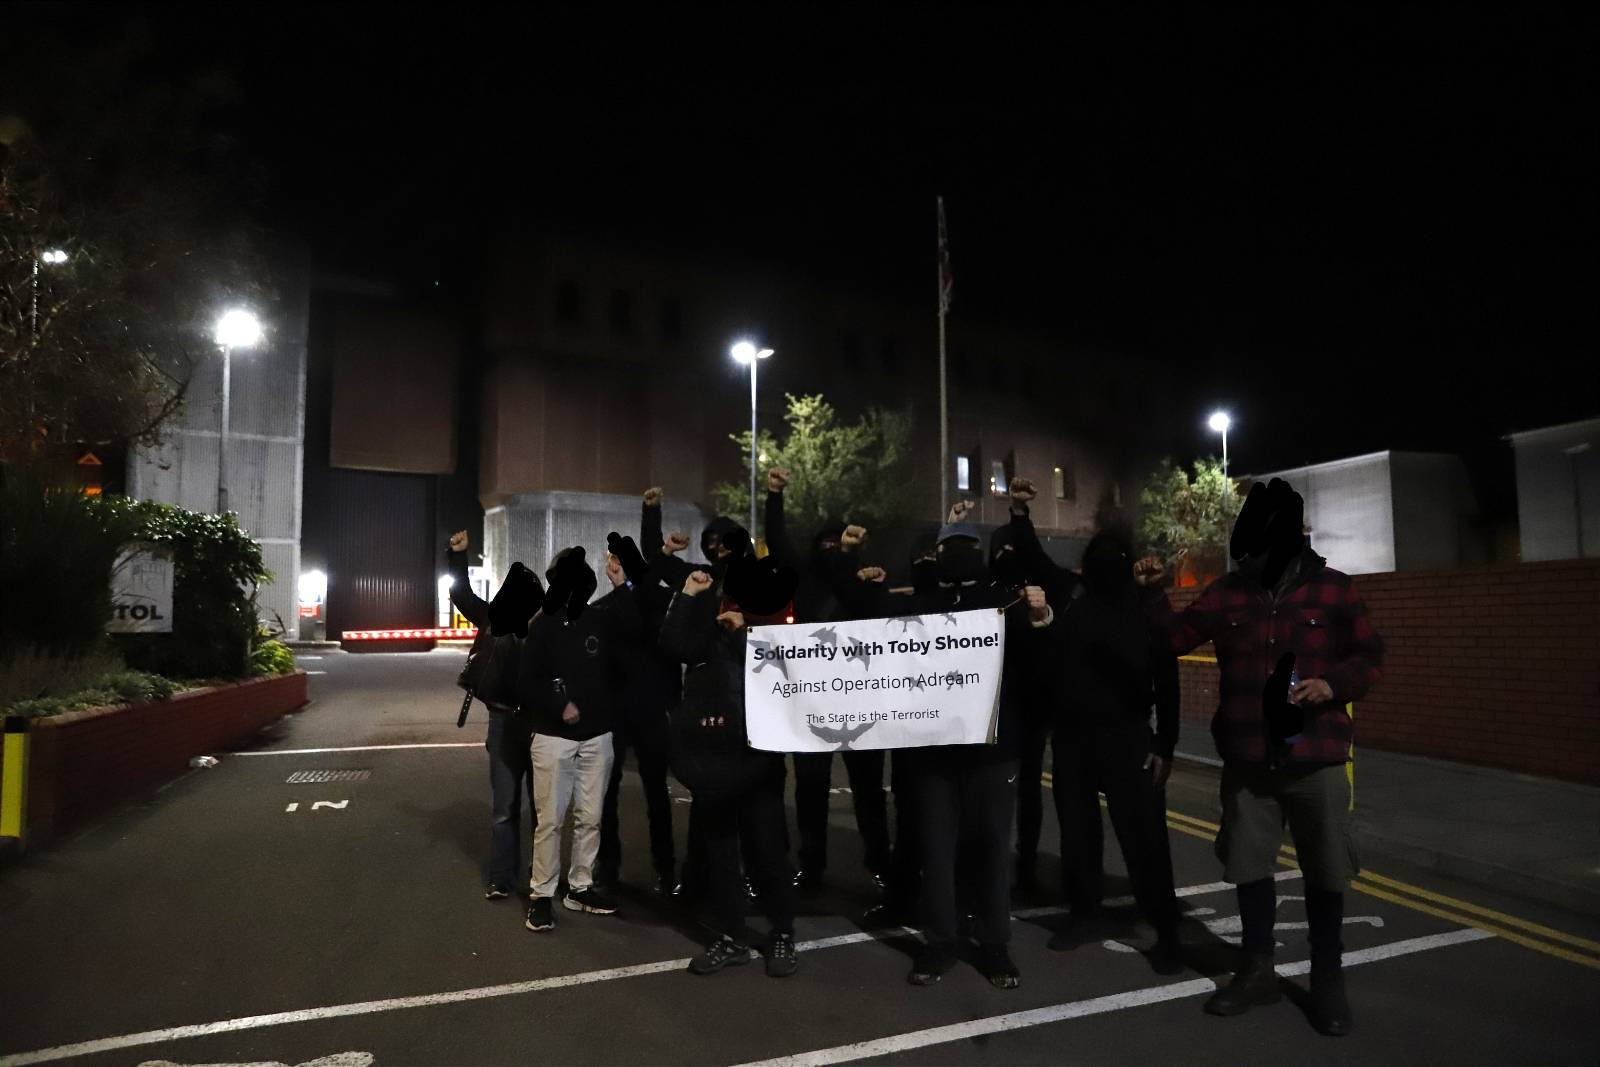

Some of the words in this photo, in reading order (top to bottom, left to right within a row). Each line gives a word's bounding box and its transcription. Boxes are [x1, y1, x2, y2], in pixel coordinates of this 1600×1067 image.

[753, 643, 838, 661] Solidarity
[842, 640, 883, 657] with
[888, 637, 930, 656] Toby
[935, 632, 999, 650] Shone!
[772, 680, 827, 698] Against
[831, 674, 912, 693] Operation
[916, 670, 980, 688] Adream
[806, 714, 825, 724] The
[828, 712, 855, 723] State
[858, 711, 867, 722] is
[870, 711, 888, 721] the
[891, 709, 940, 721] Terrorist
